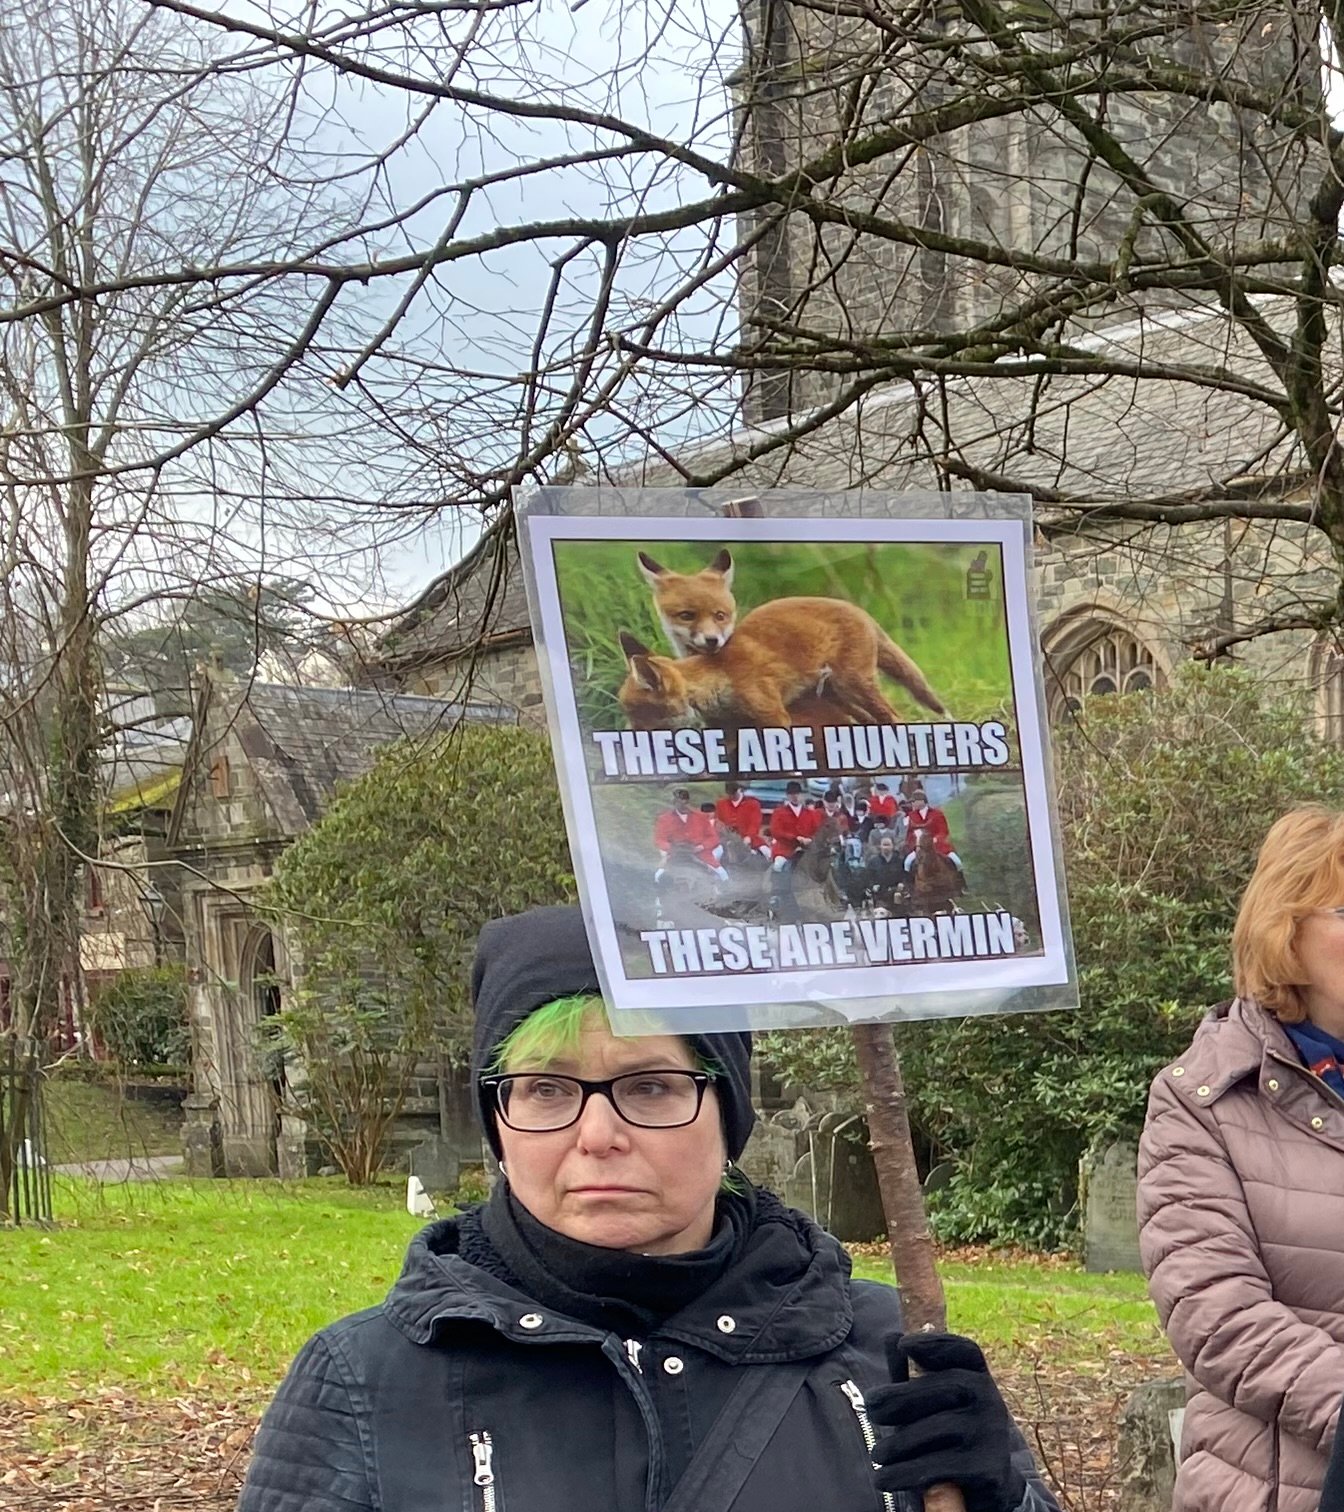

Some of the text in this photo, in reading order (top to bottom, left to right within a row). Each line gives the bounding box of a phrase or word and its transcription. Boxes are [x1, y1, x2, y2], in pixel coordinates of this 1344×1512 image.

[592, 721, 1010, 777] THESE ARE HUNTERS
[640, 911, 1018, 975] THESE ARE VERMIN
